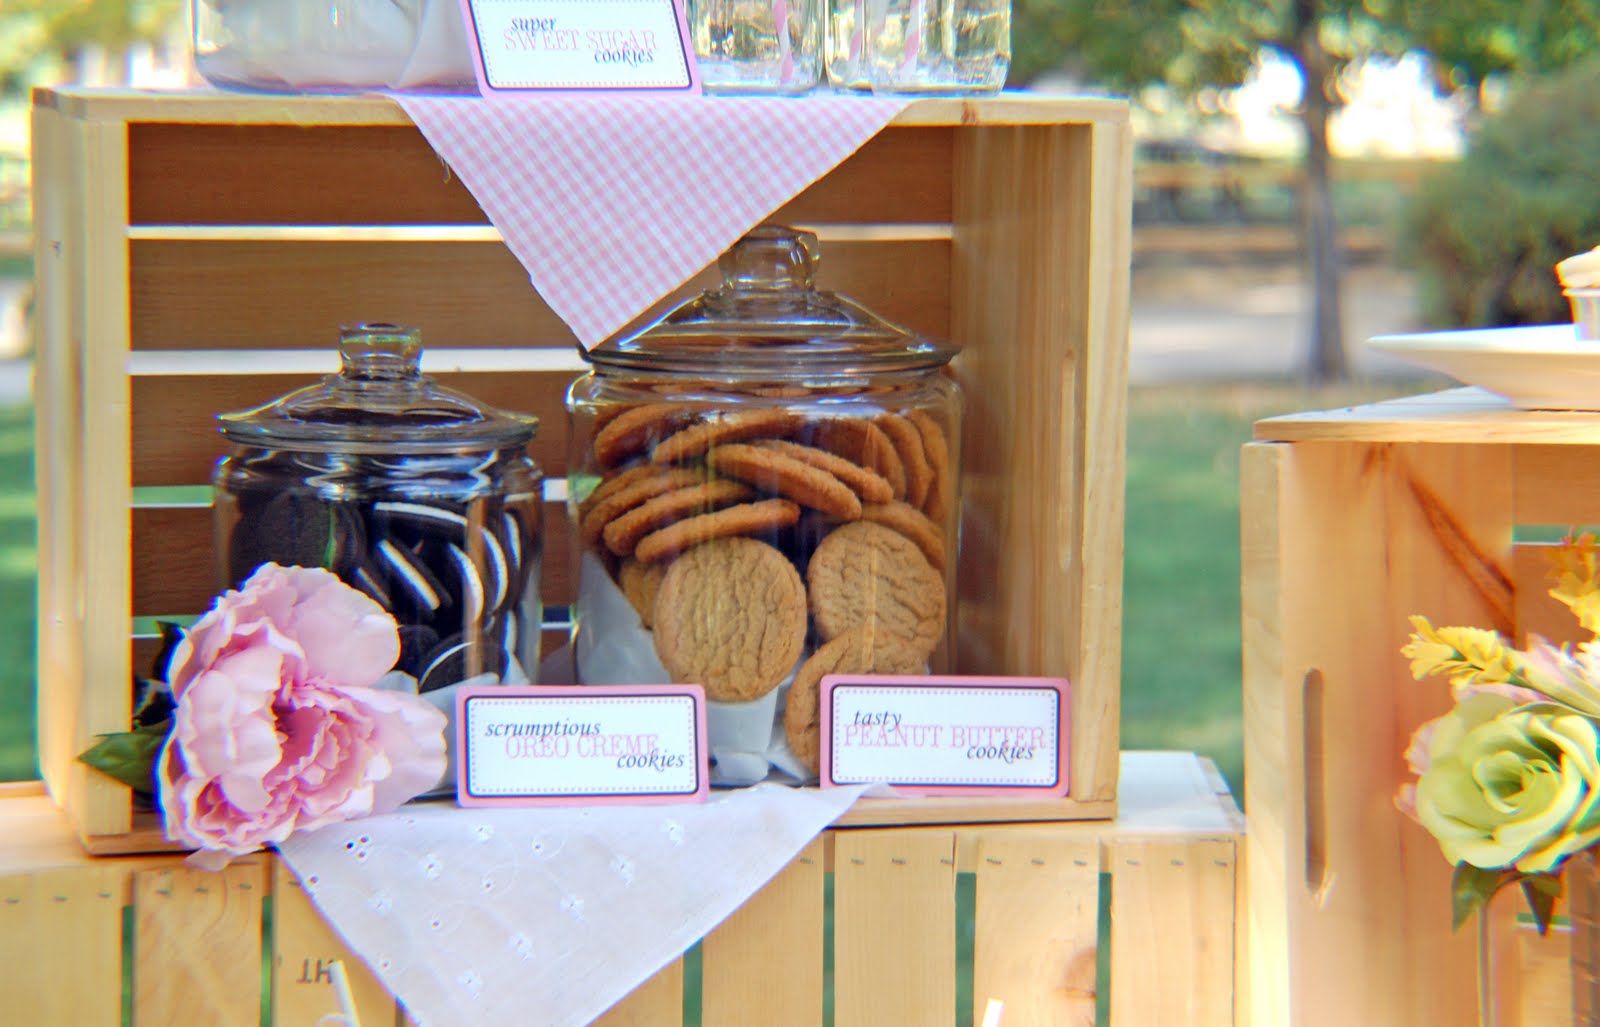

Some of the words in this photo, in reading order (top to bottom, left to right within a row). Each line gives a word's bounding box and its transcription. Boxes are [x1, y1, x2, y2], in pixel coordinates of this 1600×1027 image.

[511, 16, 556, 37] super
[503, 29, 580, 51] SWEET
[586, 29, 657, 51] SUGAR
[594, 41, 654, 67] cookies
[485, 717, 601, 742] scrumptious
[853, 709, 902, 732] tasty
[505, 734, 570, 759] OREO
[576, 733, 660, 758] CREME
[844, 724, 943, 748] PEANUT
[950, 726, 1046, 750] BUTTER
[616, 748, 685, 772] cookies
[966, 739, 1034, 764] cookies
